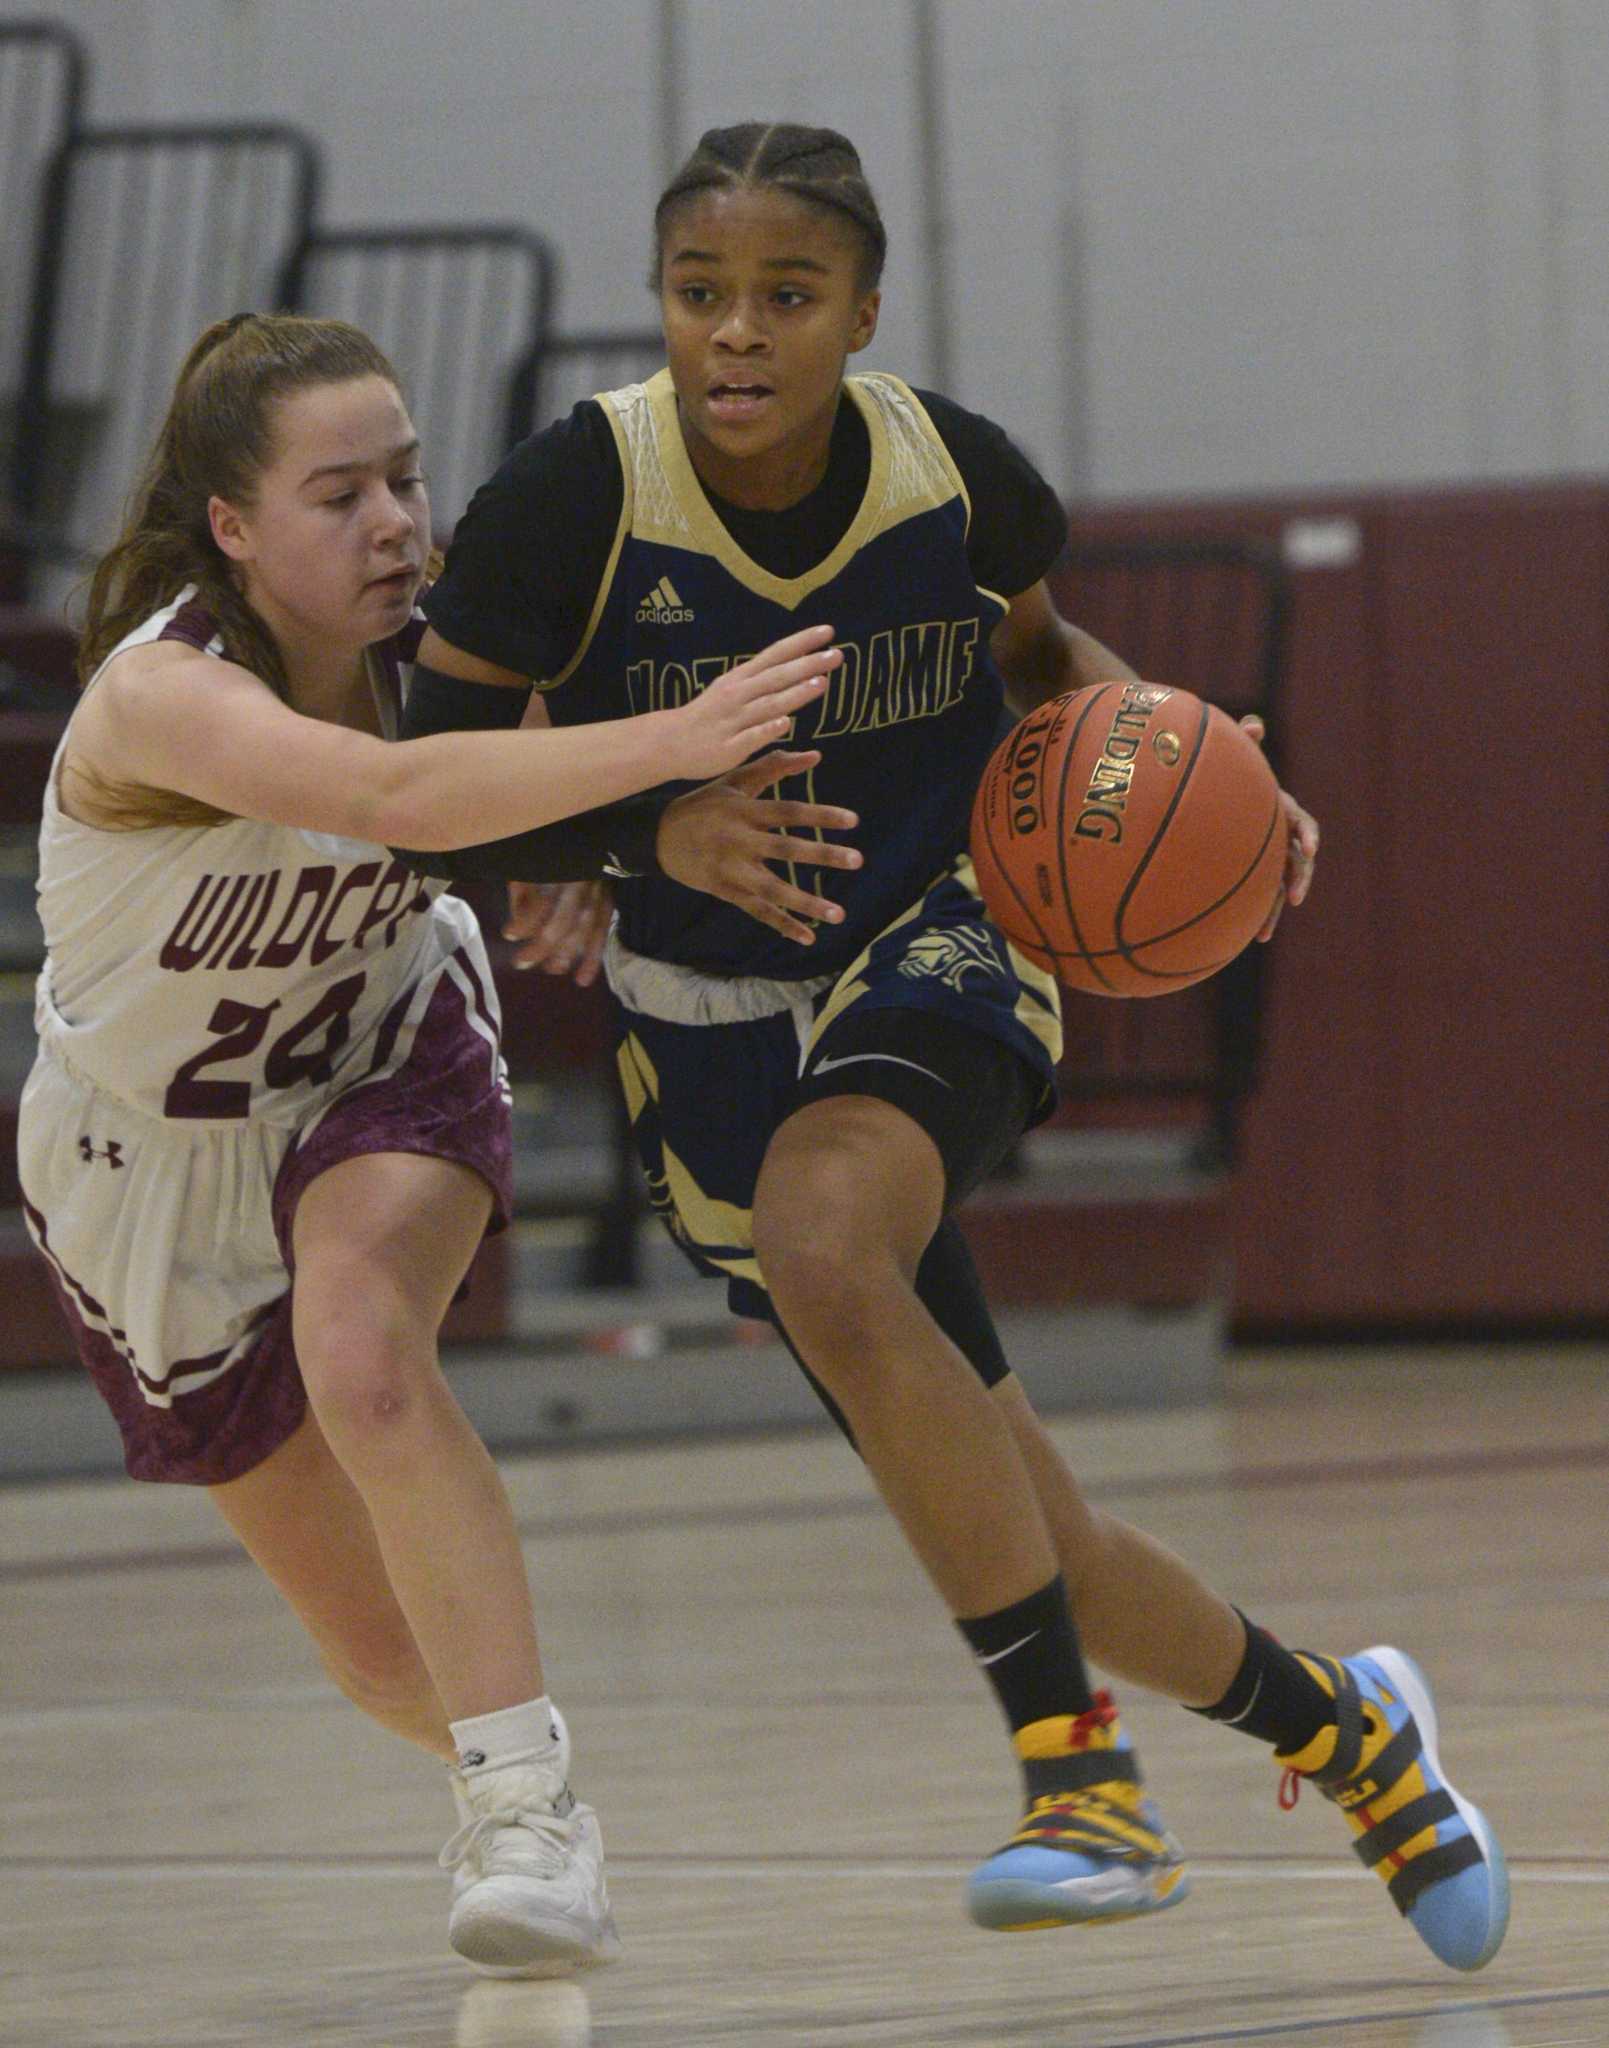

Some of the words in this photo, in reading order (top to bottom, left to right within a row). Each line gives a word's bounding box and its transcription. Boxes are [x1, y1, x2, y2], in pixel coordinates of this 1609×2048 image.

[634, 605, 695, 625] adidas
[812, 618, 980, 740] DAME
[159, 858, 431, 973] WILDCA
[163, 970, 367, 1120] 24
